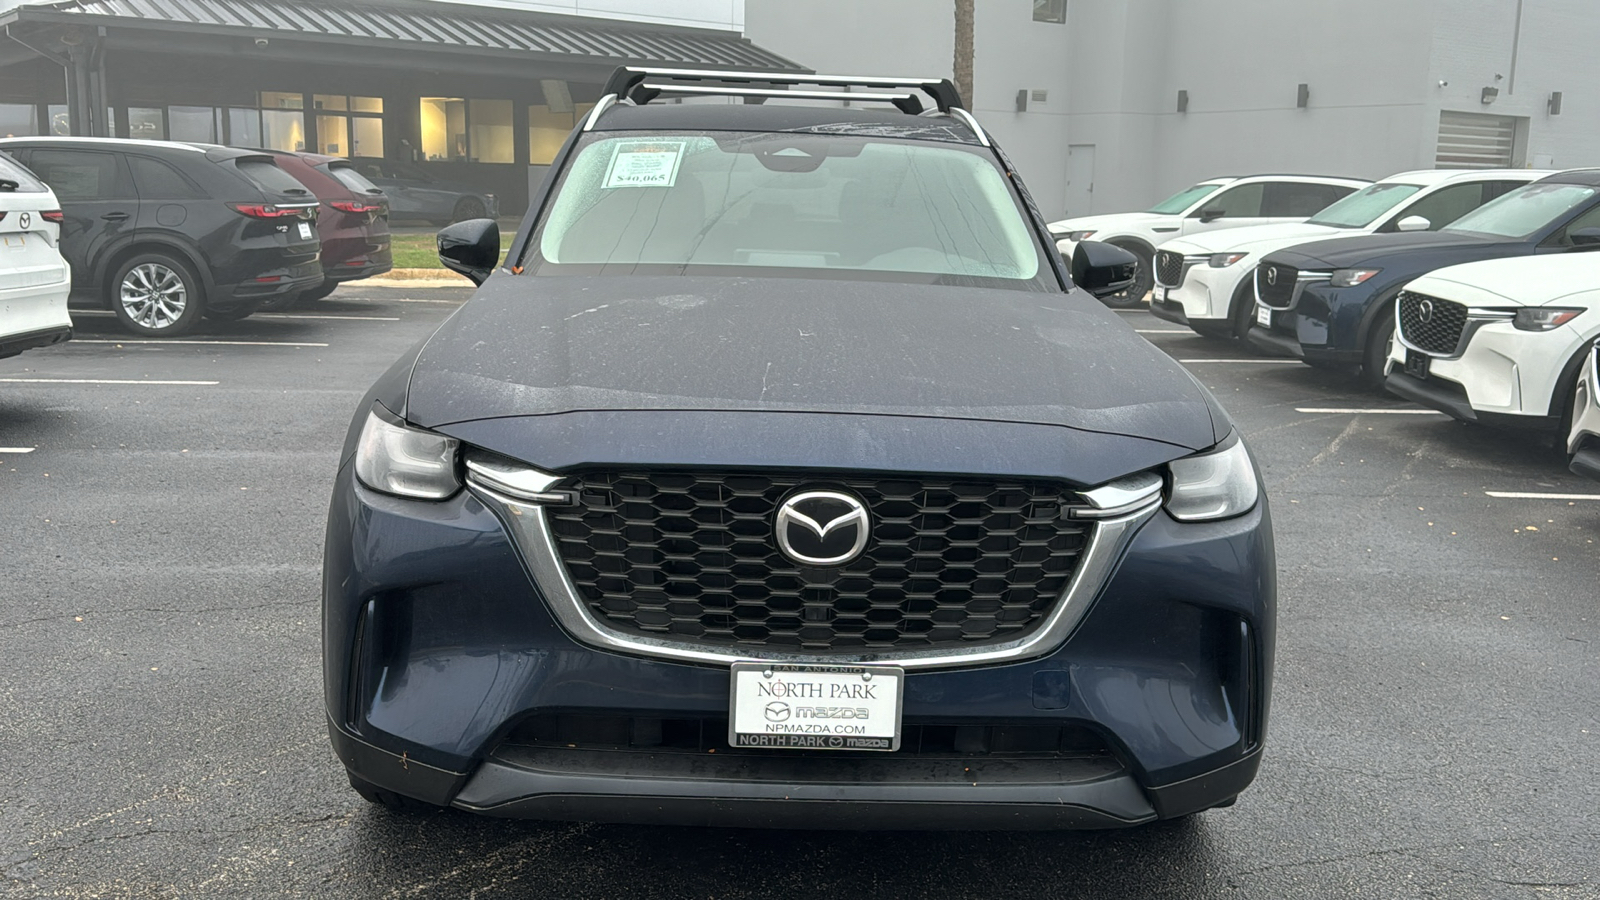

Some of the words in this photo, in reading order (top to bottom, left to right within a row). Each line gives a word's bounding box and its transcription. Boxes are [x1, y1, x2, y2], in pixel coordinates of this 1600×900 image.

[757, 681, 823, 698] NORTH
[830, 683, 877, 700] PARK
[765, 723, 866, 734] NPMAZDA.COM
[739, 735, 786, 746] NORTH
[790, 736, 826, 747] PARK
